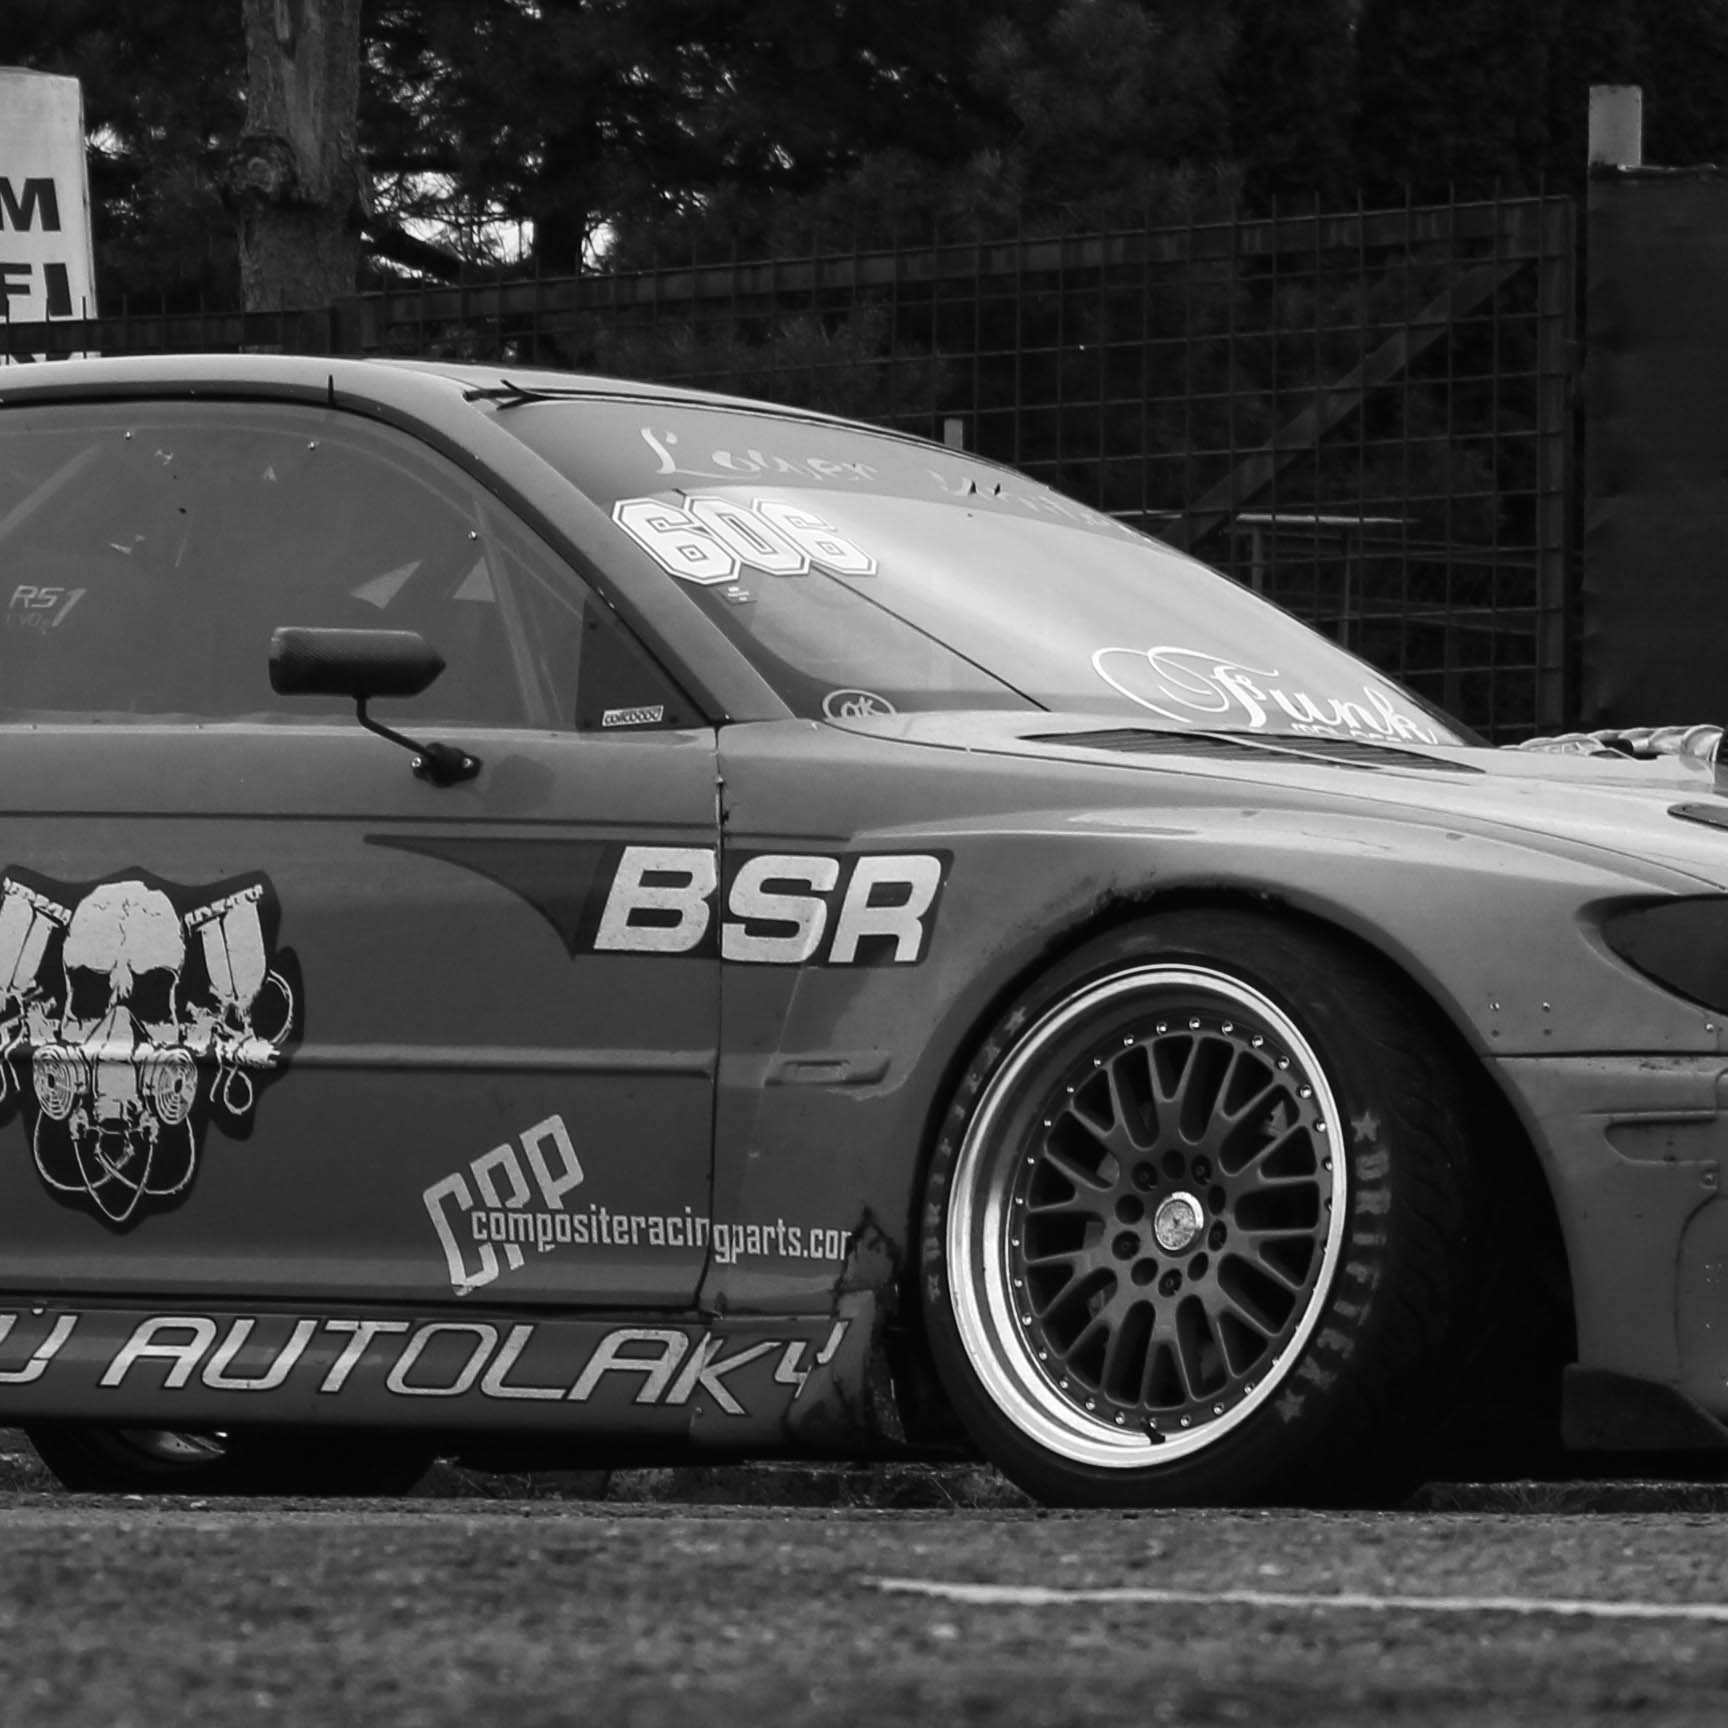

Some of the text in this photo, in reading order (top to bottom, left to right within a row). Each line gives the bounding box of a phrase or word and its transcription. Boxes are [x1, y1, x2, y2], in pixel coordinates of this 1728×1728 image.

[611, 495, 878, 586] 606
[1092, 646, 1438, 745] Funk
[593, 846, 942, 963] BSR
